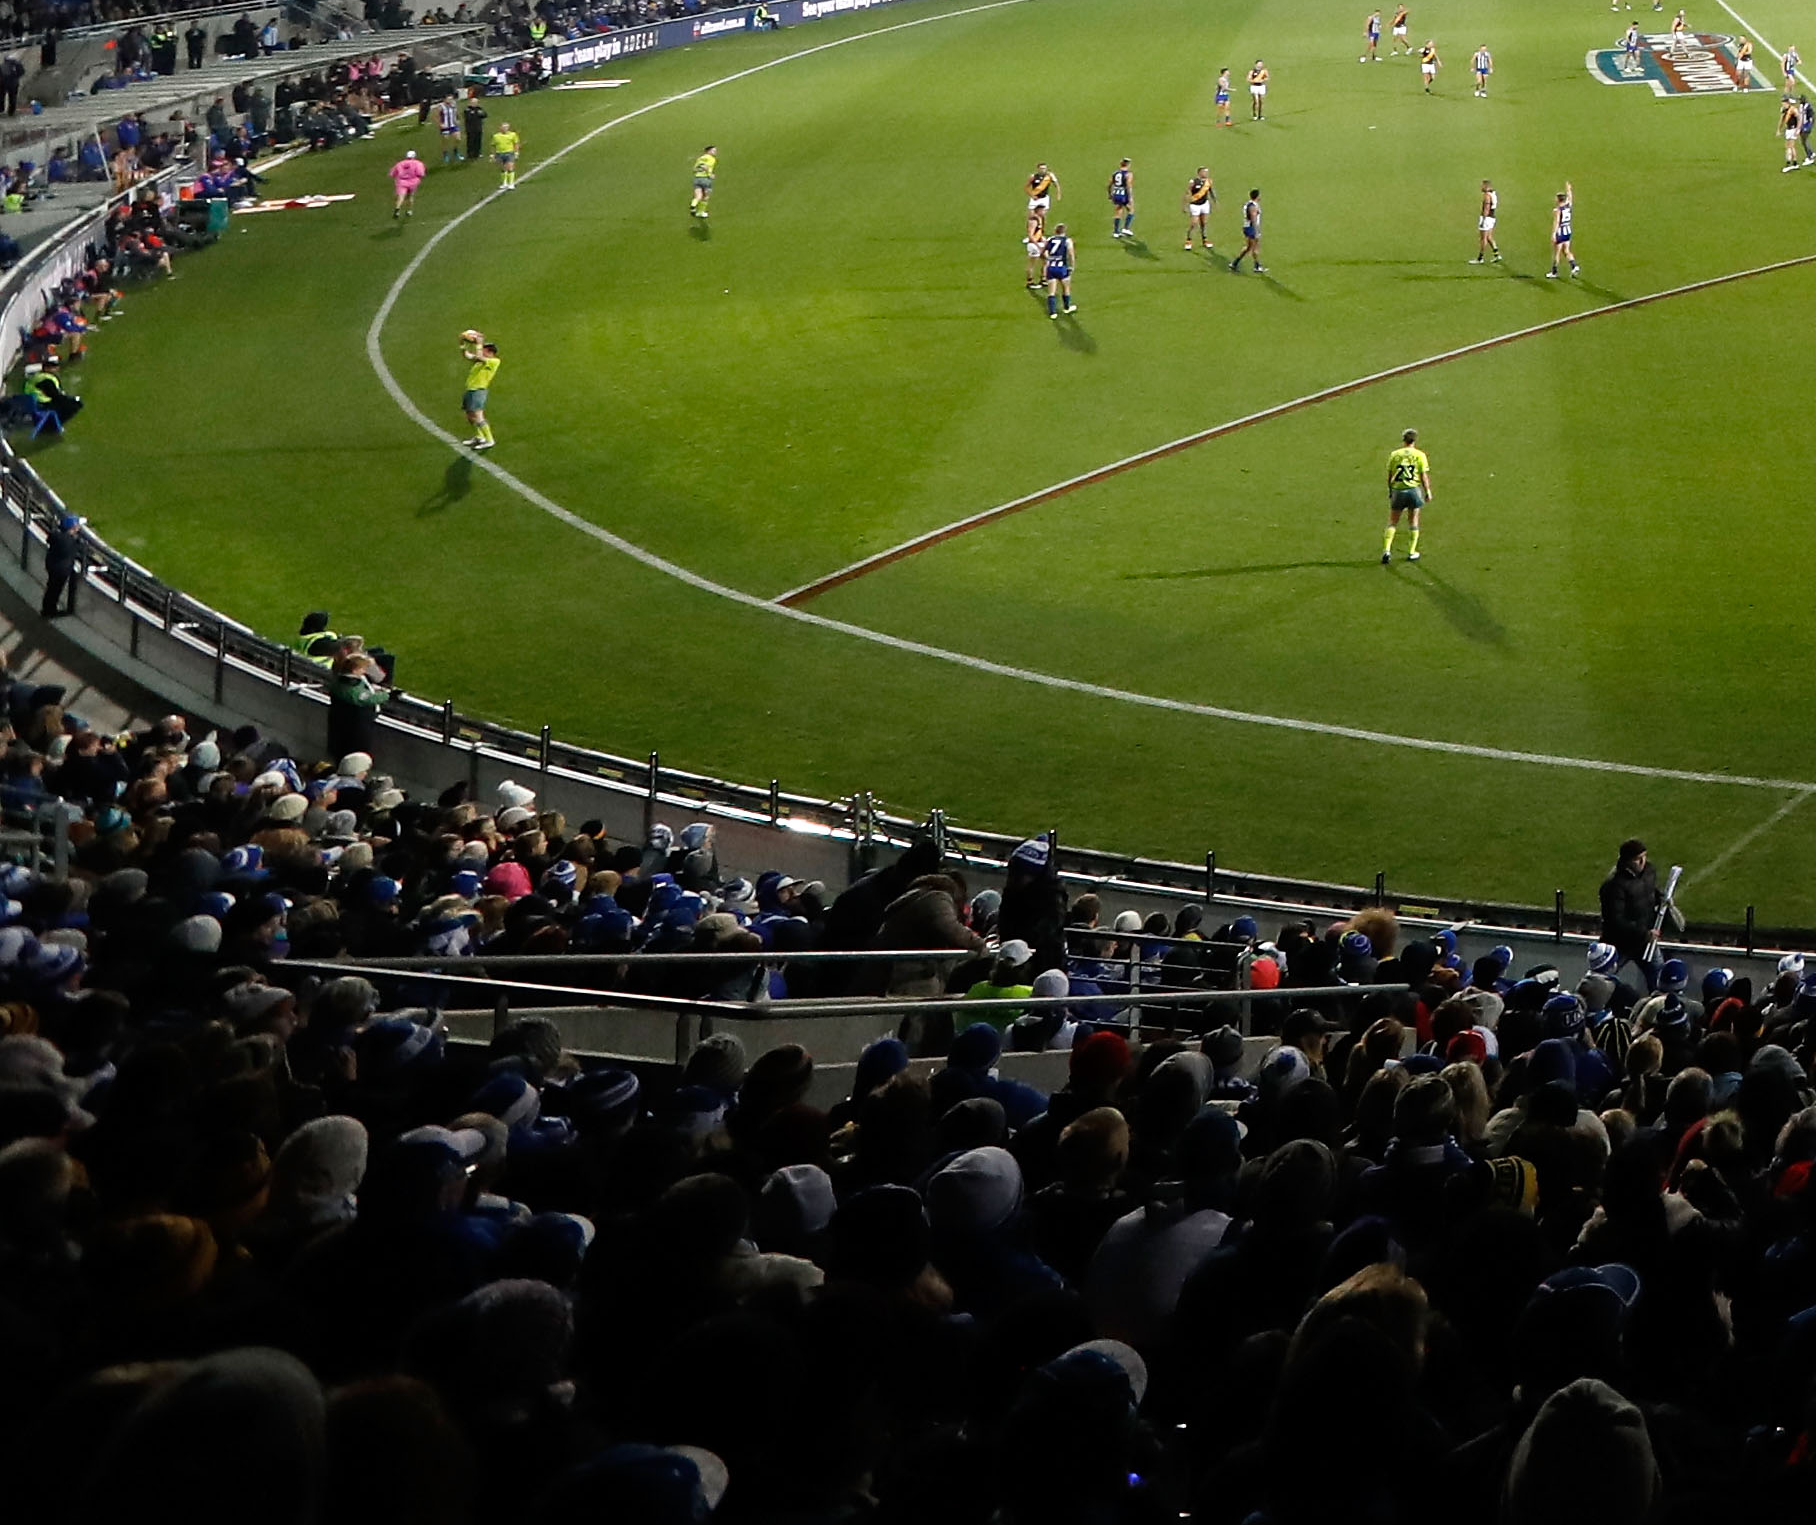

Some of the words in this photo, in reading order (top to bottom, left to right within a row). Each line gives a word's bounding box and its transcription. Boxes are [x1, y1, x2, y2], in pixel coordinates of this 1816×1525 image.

[1113, 172, 1123, 187] 9
[1049, 239, 1062, 254] 7
[1394, 464, 1417, 483] 23
